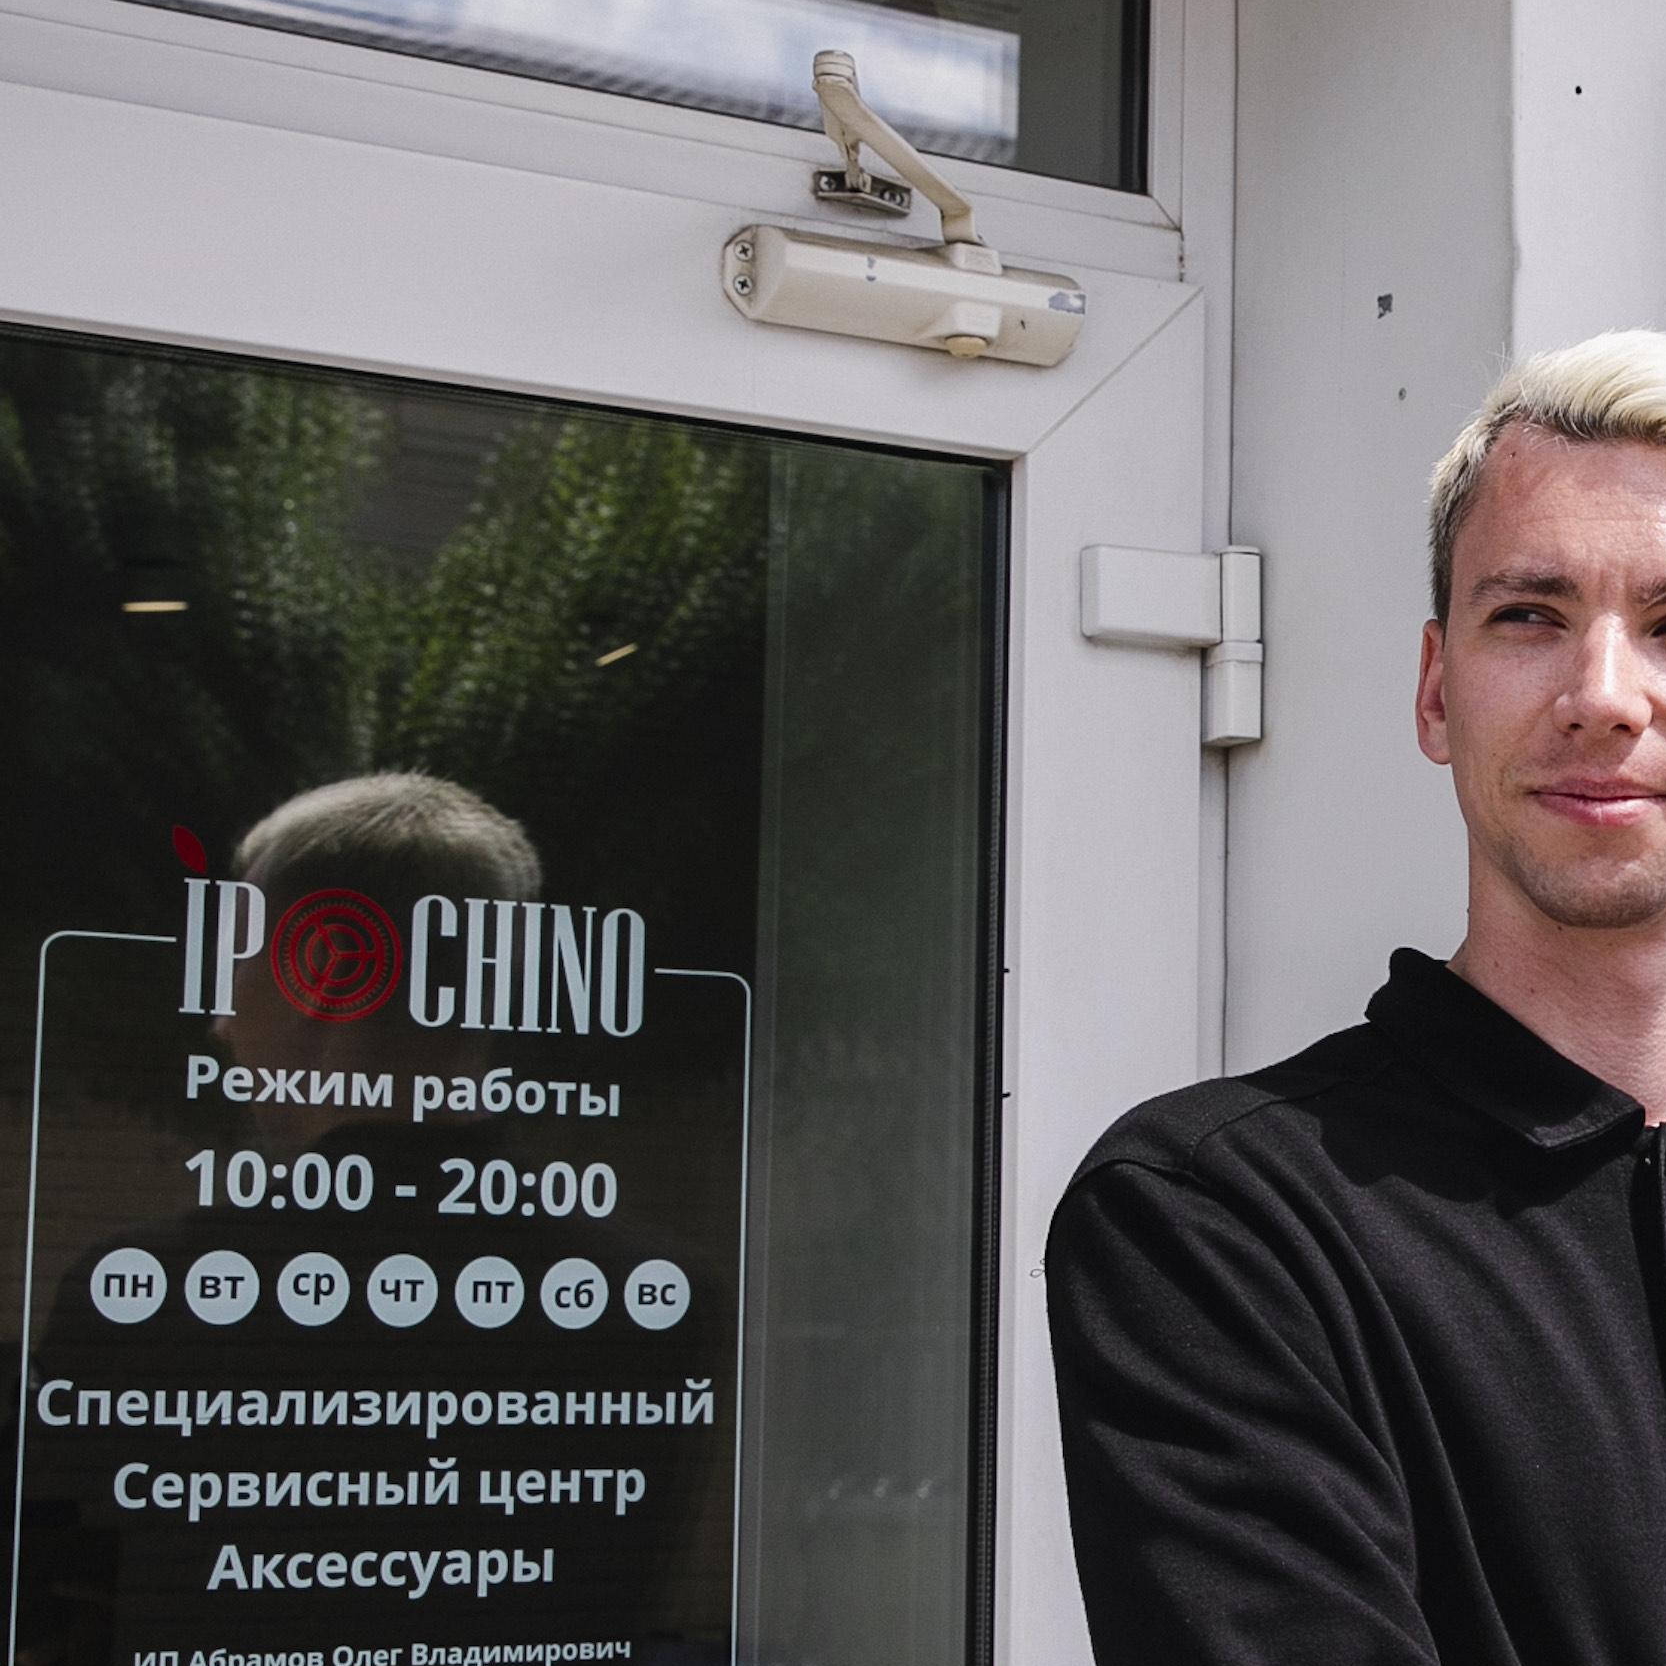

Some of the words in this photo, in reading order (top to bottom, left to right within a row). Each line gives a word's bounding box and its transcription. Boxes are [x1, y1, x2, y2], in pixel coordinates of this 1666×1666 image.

[186, 1054, 394, 1108] Режим
[412, 1068, 620, 1123] работы
[185, 1149, 374, 1212] 10:00
[438, 1157, 617, 1218] 20:00
[103, 1273, 154, 1299] пн
[199, 1275, 245, 1300] вт
[292, 1271, 336, 1306] ср
[380, 1279, 425, 1304] чт
[472, 1280, 515, 1305] пт
[554, 1277, 595, 1309] сб
[638, 1283, 677, 1307] вс
[37, 1378, 714, 1440] Специализированный
[113, 1457, 460, 1523] Сервисный
[479, 1468, 646, 1517] центр
[206, 1544, 555, 1600] Аксессуары
